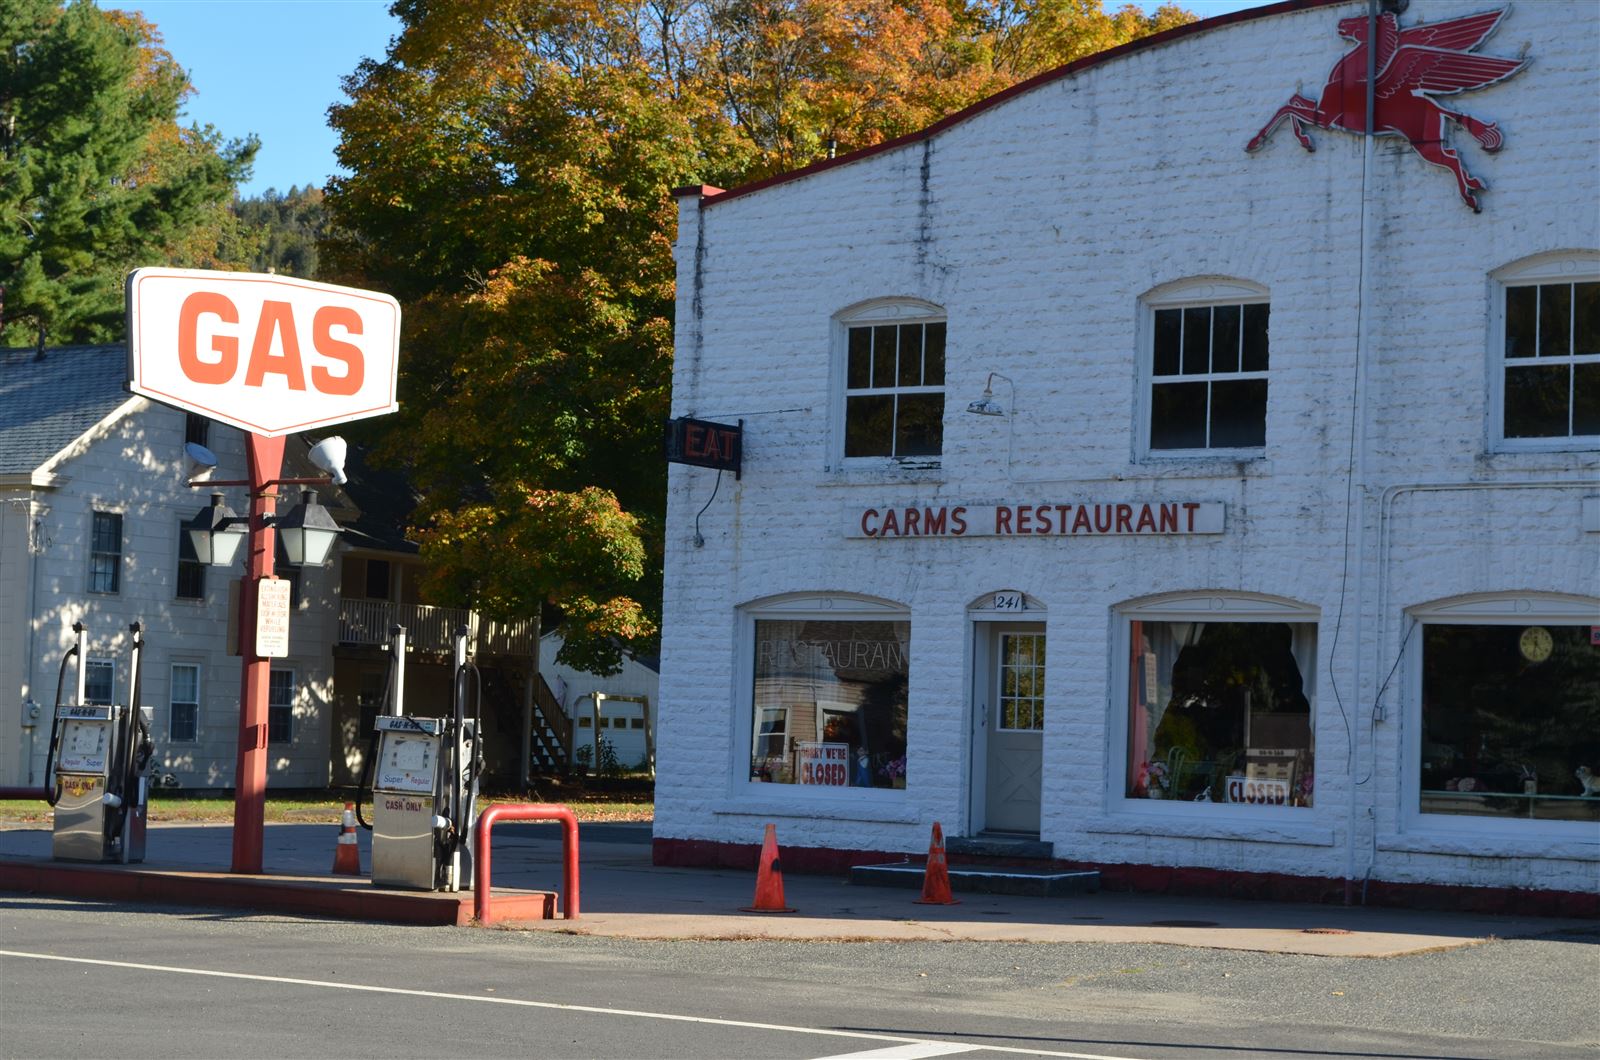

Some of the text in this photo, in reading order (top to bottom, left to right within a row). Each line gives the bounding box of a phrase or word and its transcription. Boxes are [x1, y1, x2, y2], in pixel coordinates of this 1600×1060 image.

[178, 291, 365, 396] GAS
[686, 423, 740, 461] EAT
[861, 503, 1200, 537] CARMS RESTAURANT
[997, 596, 1020, 608] 241
[760, 641, 902, 670] RESTAURAN
[86, 758, 104, 768] Super
[825, 748, 846, 760] WE'RE
[384, 774, 430, 786] Super Regular
[801, 762, 846, 786] CLOSED
[64, 780, 80, 790] CASH
[1229, 781, 1284, 805] CLOSED
[385, 800, 403, 811] CASH
[405, 801, 422, 812] ONLY
